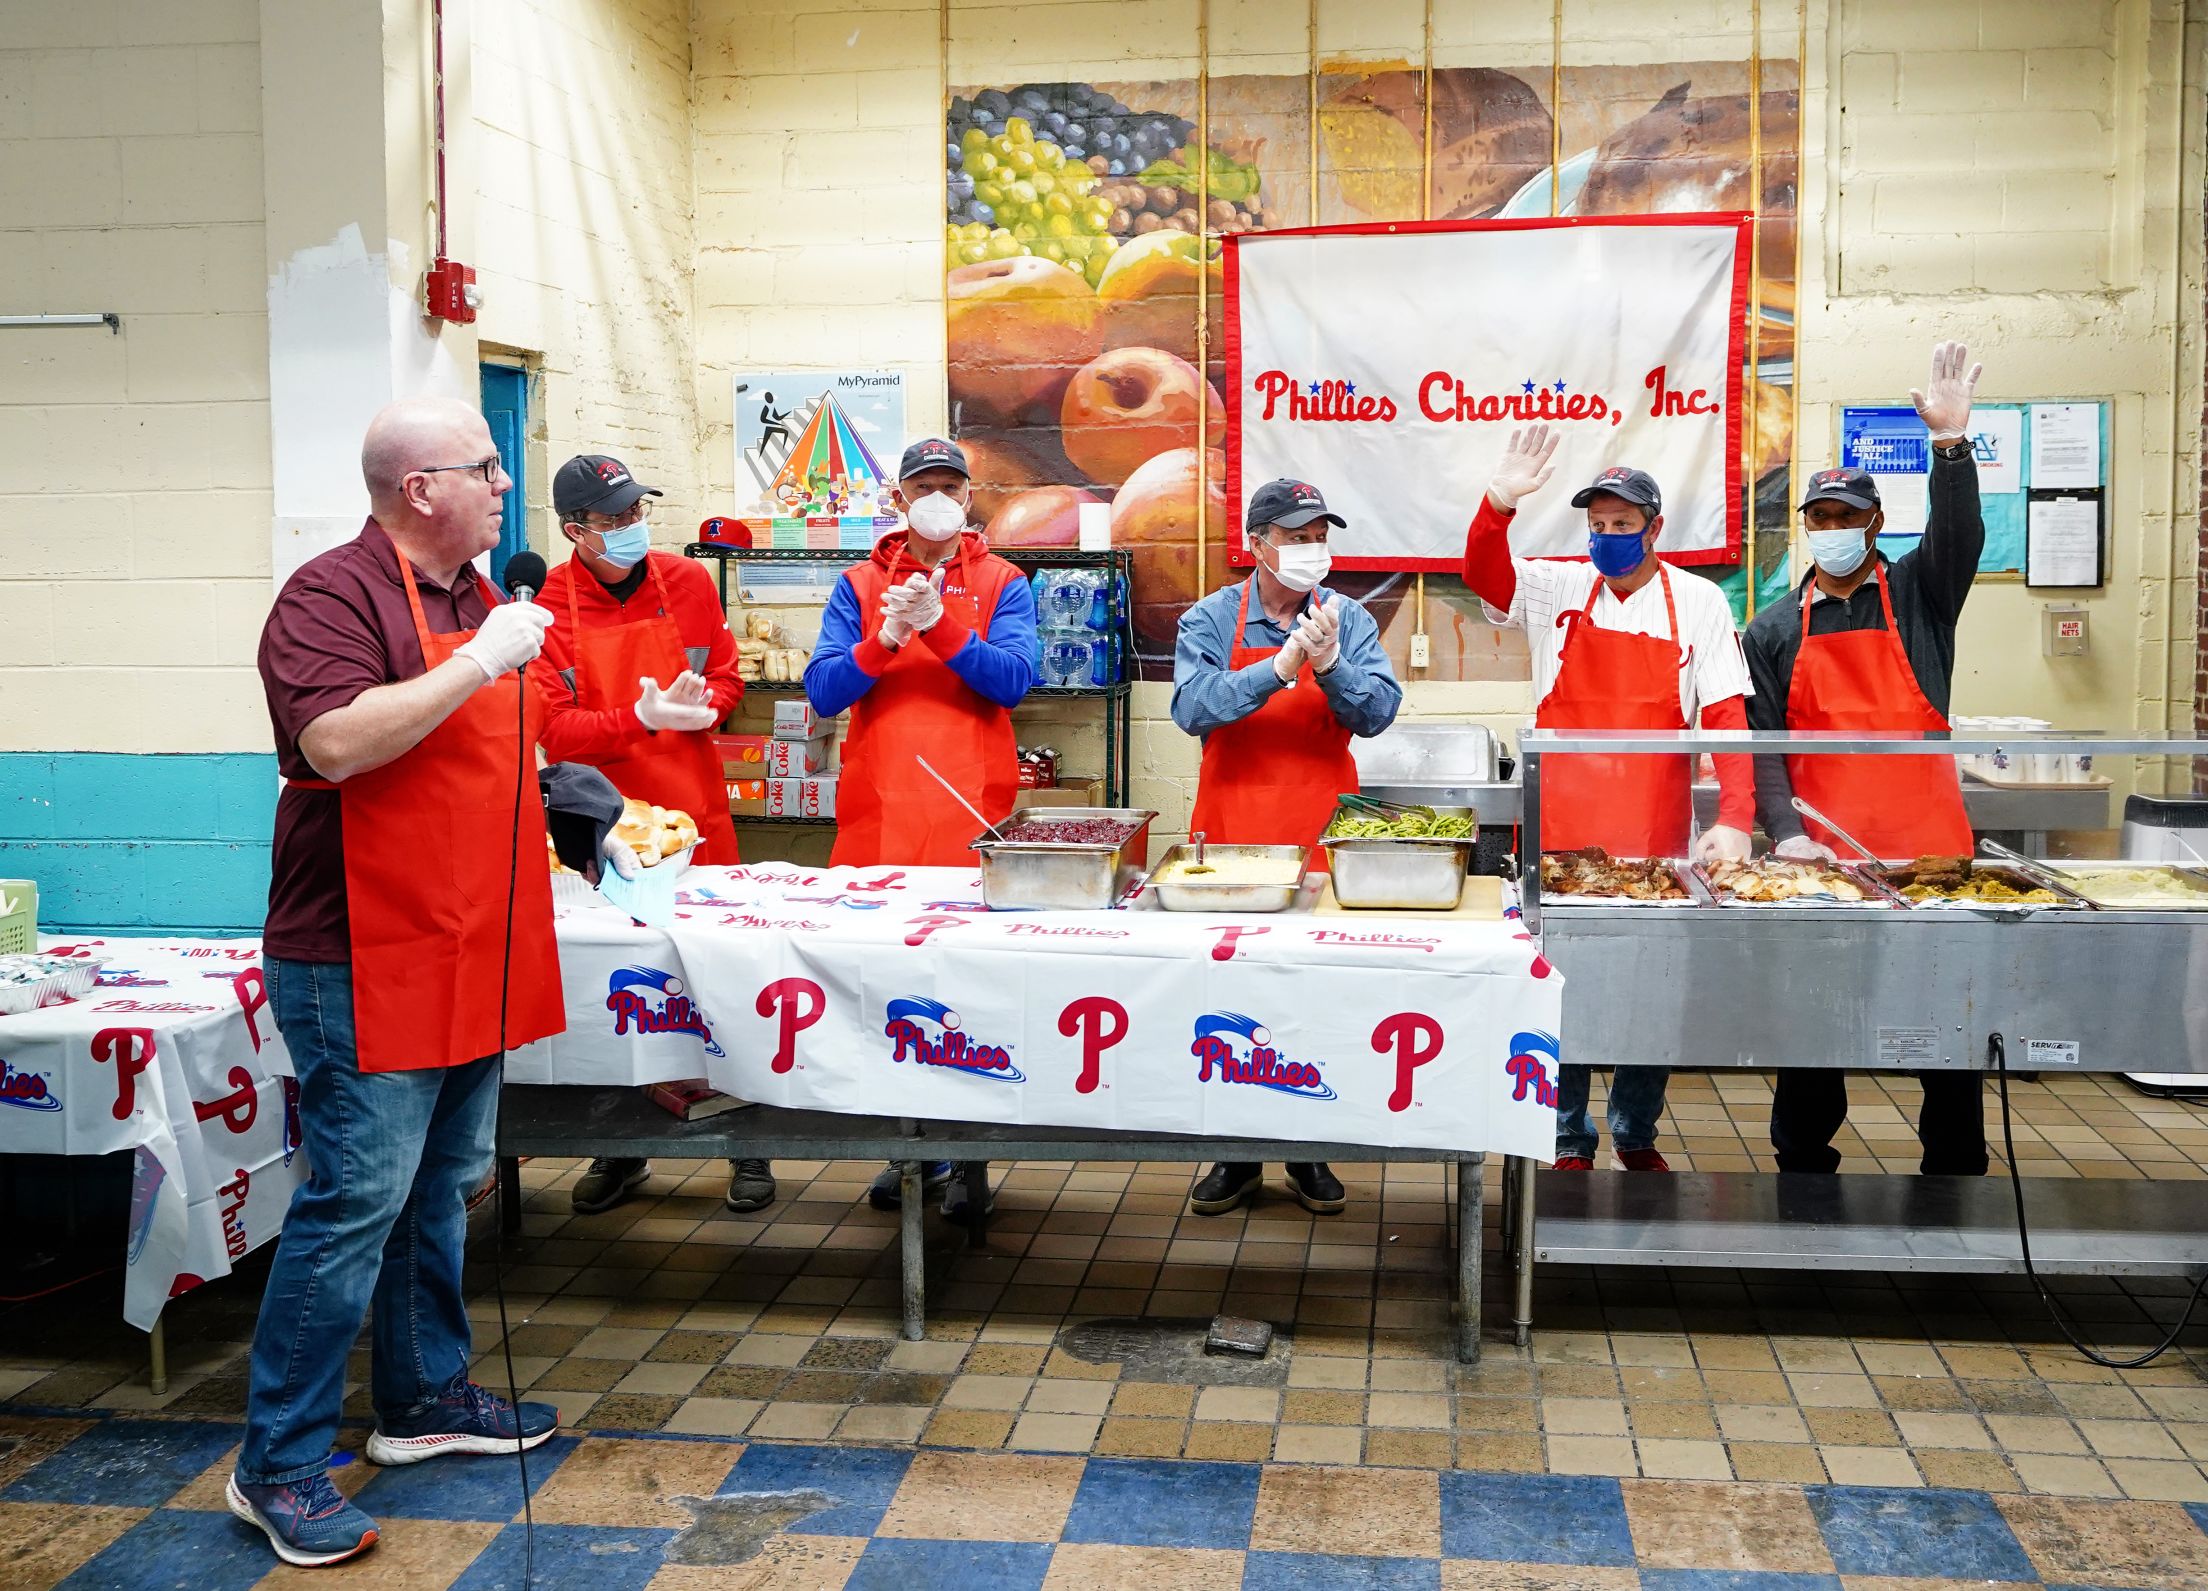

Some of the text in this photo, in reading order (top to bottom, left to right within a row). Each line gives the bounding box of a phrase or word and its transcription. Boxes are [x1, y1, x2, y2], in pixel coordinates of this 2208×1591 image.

[838, 374, 900, 389] MyPyramid
[1254, 365, 1720, 426] Phillies Charities, Inc.
[1852, 445, 1894, 453] JUSTICE
[1863, 452, 1882, 460] ALL
[775, 741, 789, 777] Coke
[770, 780, 784, 816] Coke
[805, 781, 819, 817] Coke
[1003, 923, 1130, 937] Phillies
[1307, 930, 1443, 945] Phillies
[755, 977, 826, 1074] P
[885, 1018, 1011, 1071] Phillies
[1057, 996, 1130, 1094] P
[90, 1028, 157, 1121] P
[1191, 1035, 1322, 1089] Phillies
[1371, 1012, 1445, 1113] P
[193, 1065, 258, 1134] P
